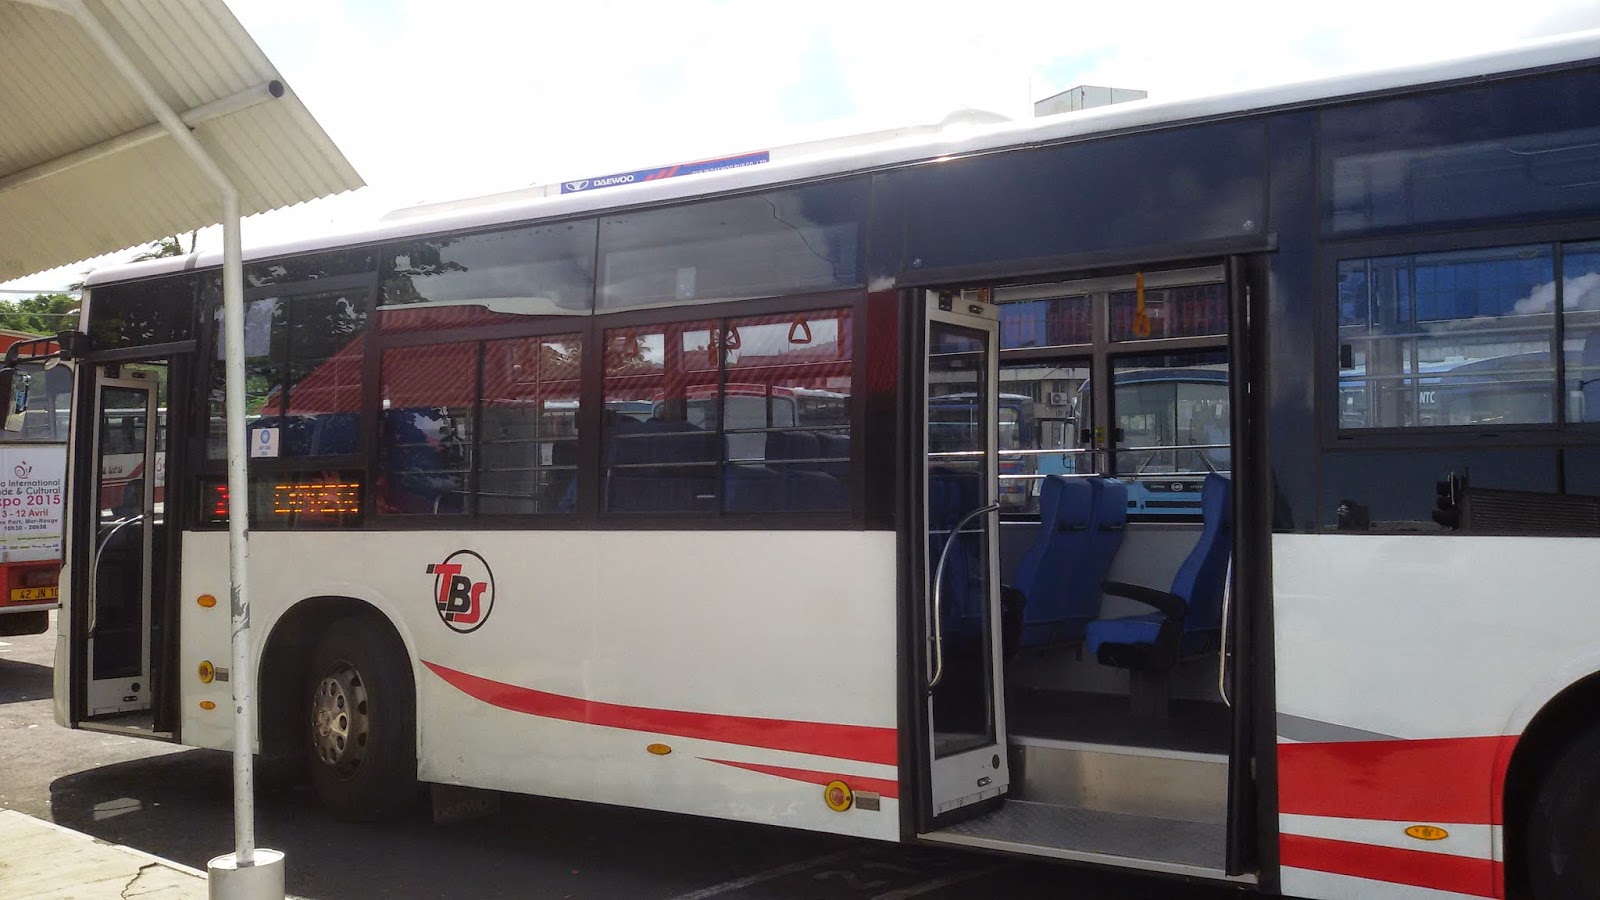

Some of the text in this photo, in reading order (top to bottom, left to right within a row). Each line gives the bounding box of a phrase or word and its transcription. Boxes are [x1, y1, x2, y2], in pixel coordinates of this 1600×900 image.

[594, 175, 634, 187] DAEWOO
[1420, 391, 1435, 404] NTC
[9, 479, 61, 487] International
[16, 487, 23, 495] &
[26, 486, 61, 495] Cultural
[27, 495, 61, 506] 2015
[28, 508, 49, 517] Avril
[20, 590, 31, 599] 42
[35, 588, 46, 598] JN
[426, 564, 487, 624] TBS
